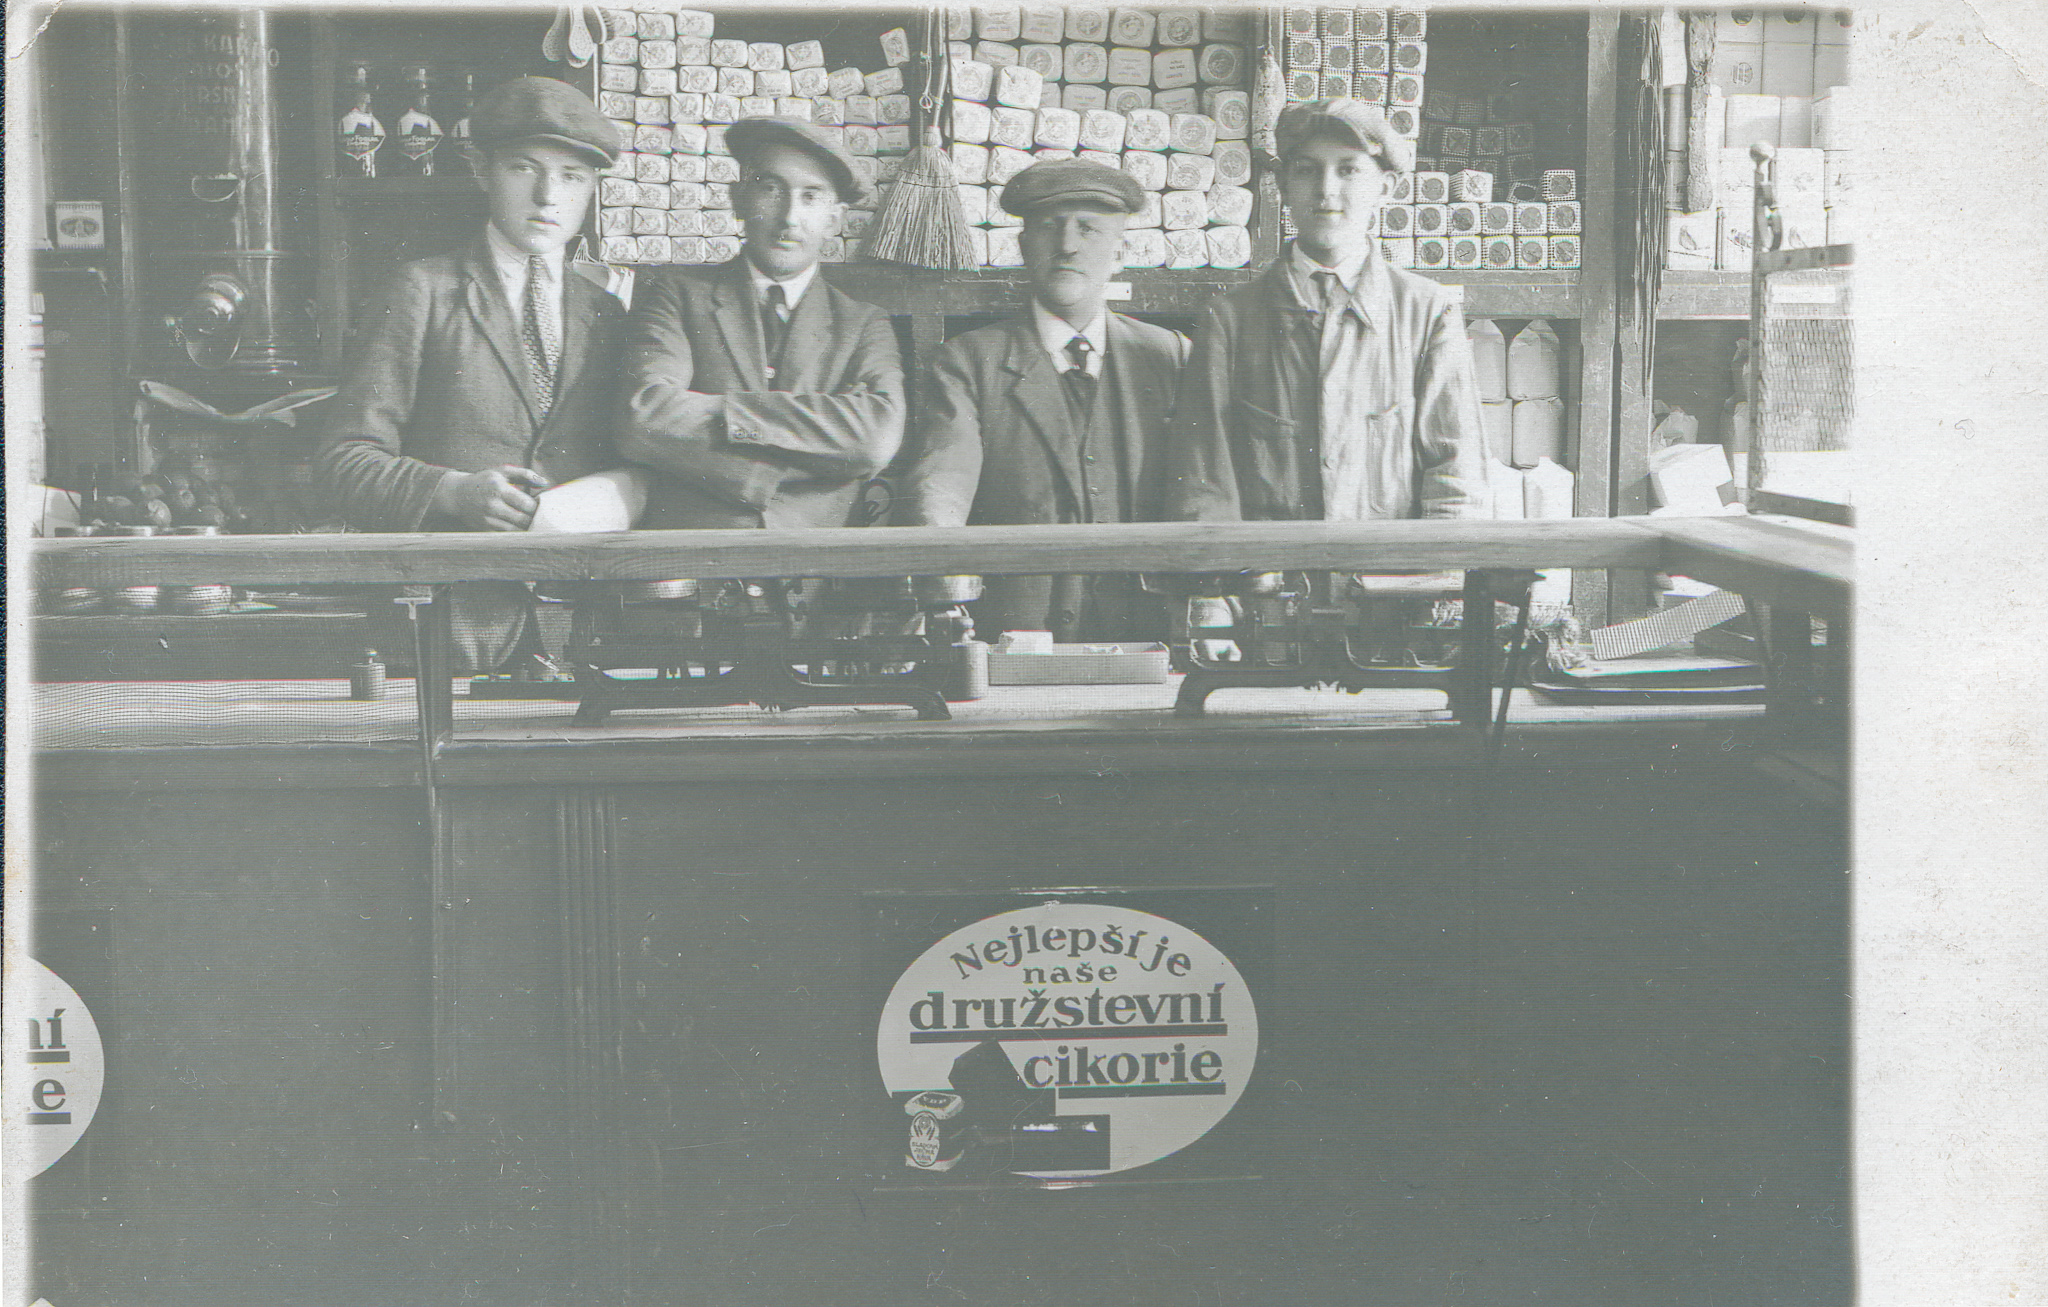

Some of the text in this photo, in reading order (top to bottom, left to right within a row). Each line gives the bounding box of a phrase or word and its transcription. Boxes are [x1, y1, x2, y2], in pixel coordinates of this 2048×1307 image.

[950, 925, 1191, 980] Nejlepší je
[1023, 962, 1118, 984] naše
[909, 983, 1225, 1030] družstevní
[1023, 1043, 1224, 1088] cikorie
